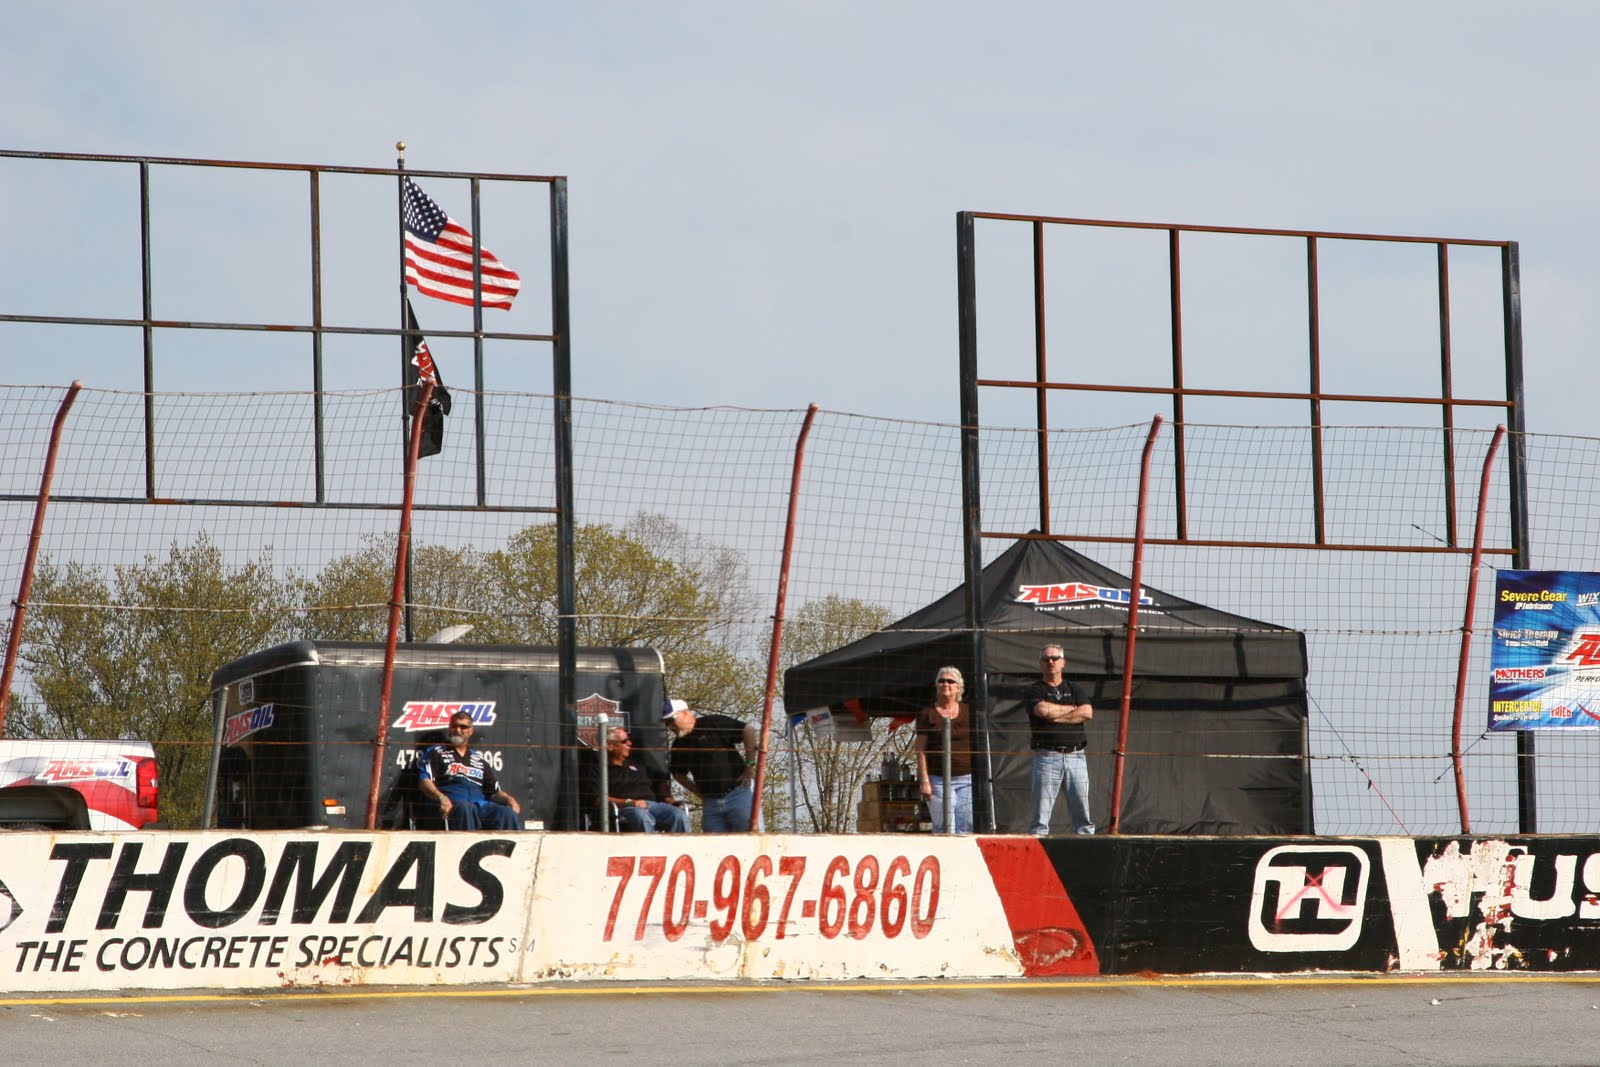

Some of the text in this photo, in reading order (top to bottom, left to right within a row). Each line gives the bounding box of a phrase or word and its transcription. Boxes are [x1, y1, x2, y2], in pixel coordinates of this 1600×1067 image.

[1019, 583, 1153, 605] AMSOIL
[1501, 589, 1568, 602] Severe Gear
[1577, 592, 1600, 604] WIX
[1494, 668, 1546, 680] MOTHERS
[395, 702, 496, 731] AMSOIL
[1493, 700, 1543, 713] INTERCEPTOR
[224, 704, 274, 746] AMSOIL
[39, 759, 131, 783] AMSOIL
[45, 837, 517, 934] THOMAS
[601, 853, 942, 943] 770-967-6860
[15, 940, 88, 973] THE
[96, 936, 290, 973] CONCRETE
[295, 934, 506, 968] SPECIALISTS
